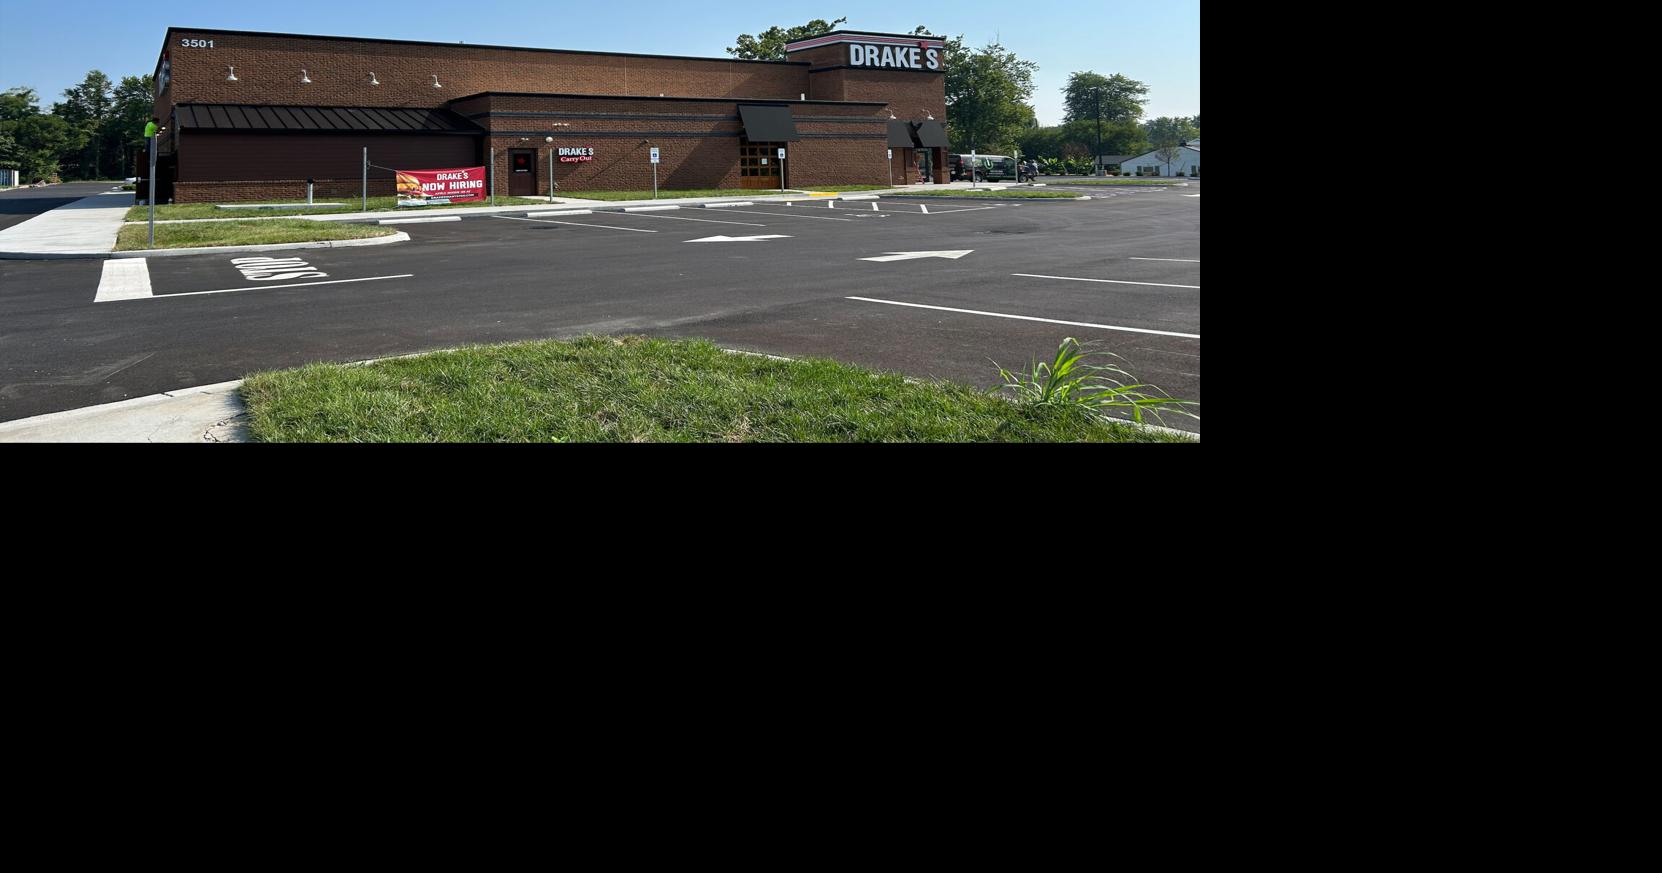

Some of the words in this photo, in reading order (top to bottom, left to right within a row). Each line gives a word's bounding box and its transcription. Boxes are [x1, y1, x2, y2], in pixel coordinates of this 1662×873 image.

[181, 38, 214, 48] 3501
[422, 182, 445, 192] NOW
[449, 180, 483, 190] HIRING
[230, 257, 329, 280] STOP
